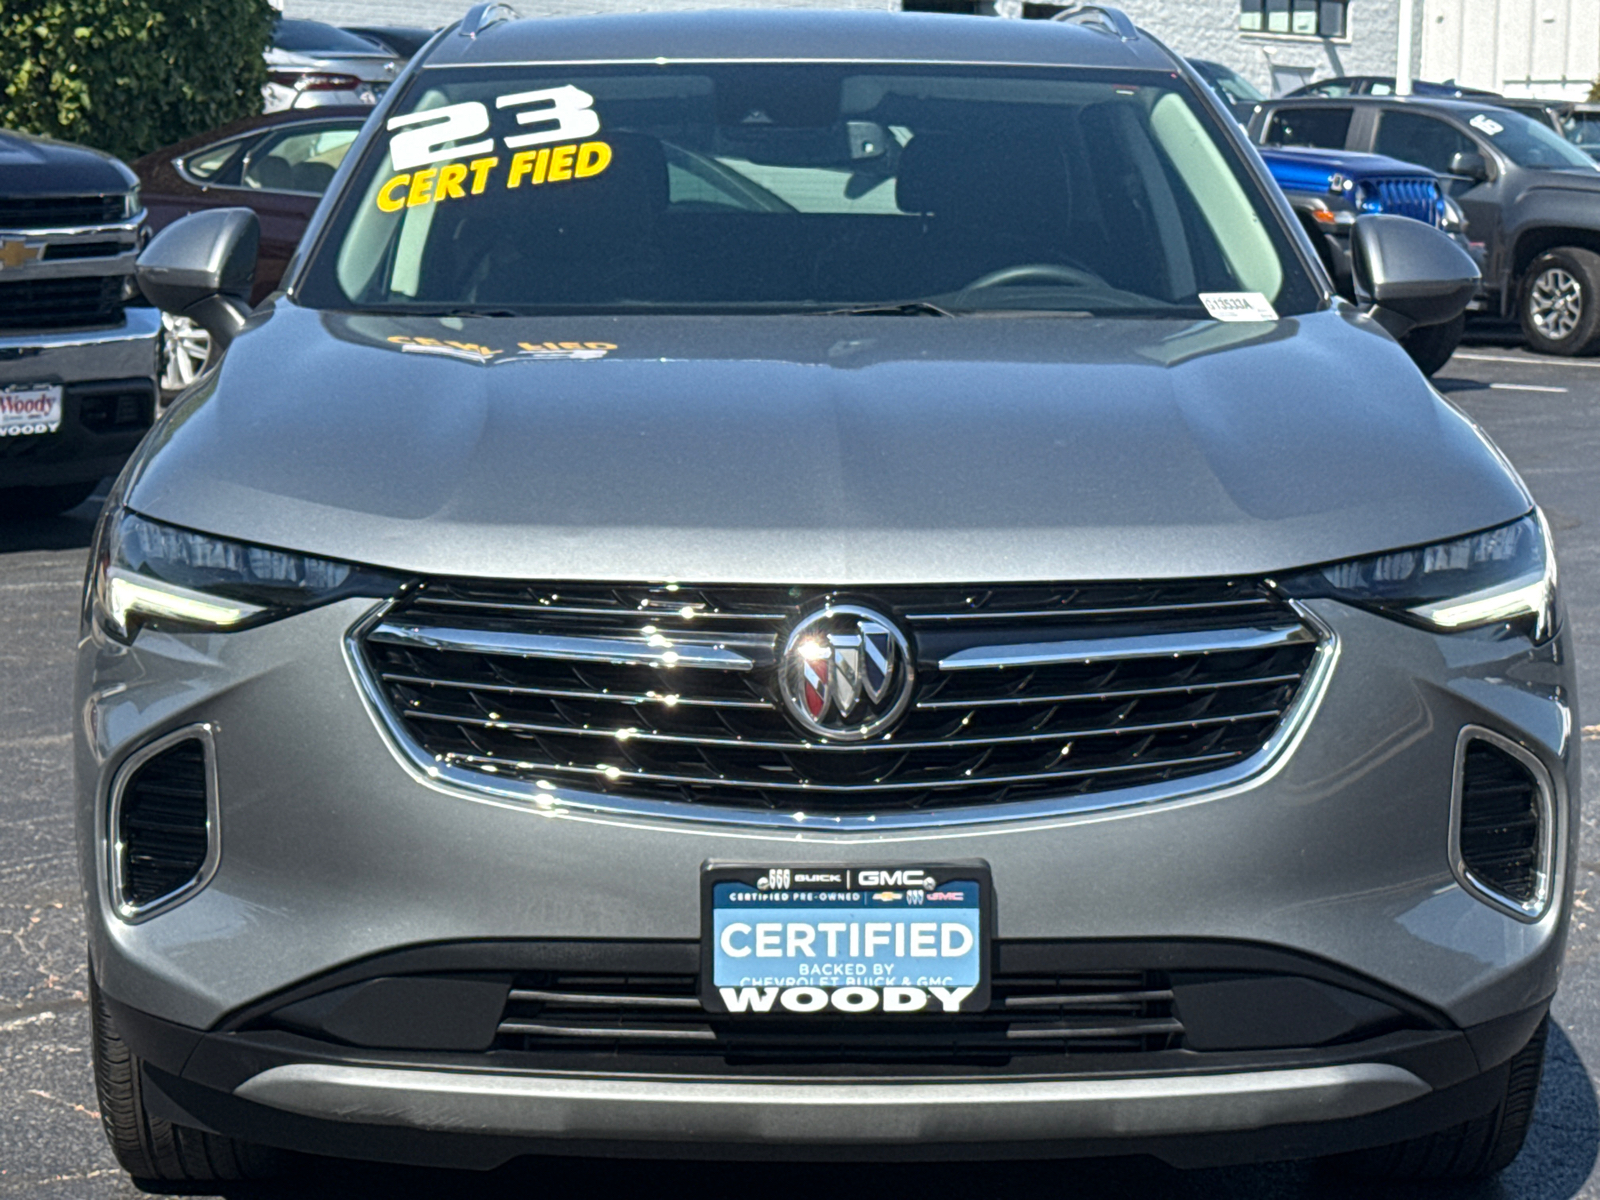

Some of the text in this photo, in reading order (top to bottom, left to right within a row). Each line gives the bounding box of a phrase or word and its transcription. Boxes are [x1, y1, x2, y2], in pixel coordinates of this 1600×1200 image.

[387, 84, 600, 171] 23
[794, 870, 925, 886] BUICK GMC
[729, 892, 789, 901] CERTIFIED
[793, 892, 860, 901] PRE-OWNED
[720, 922, 974, 957] CERTIFIED
[799, 963, 895, 976] BACKED BY
[719, 987, 975, 1013] WOODY
